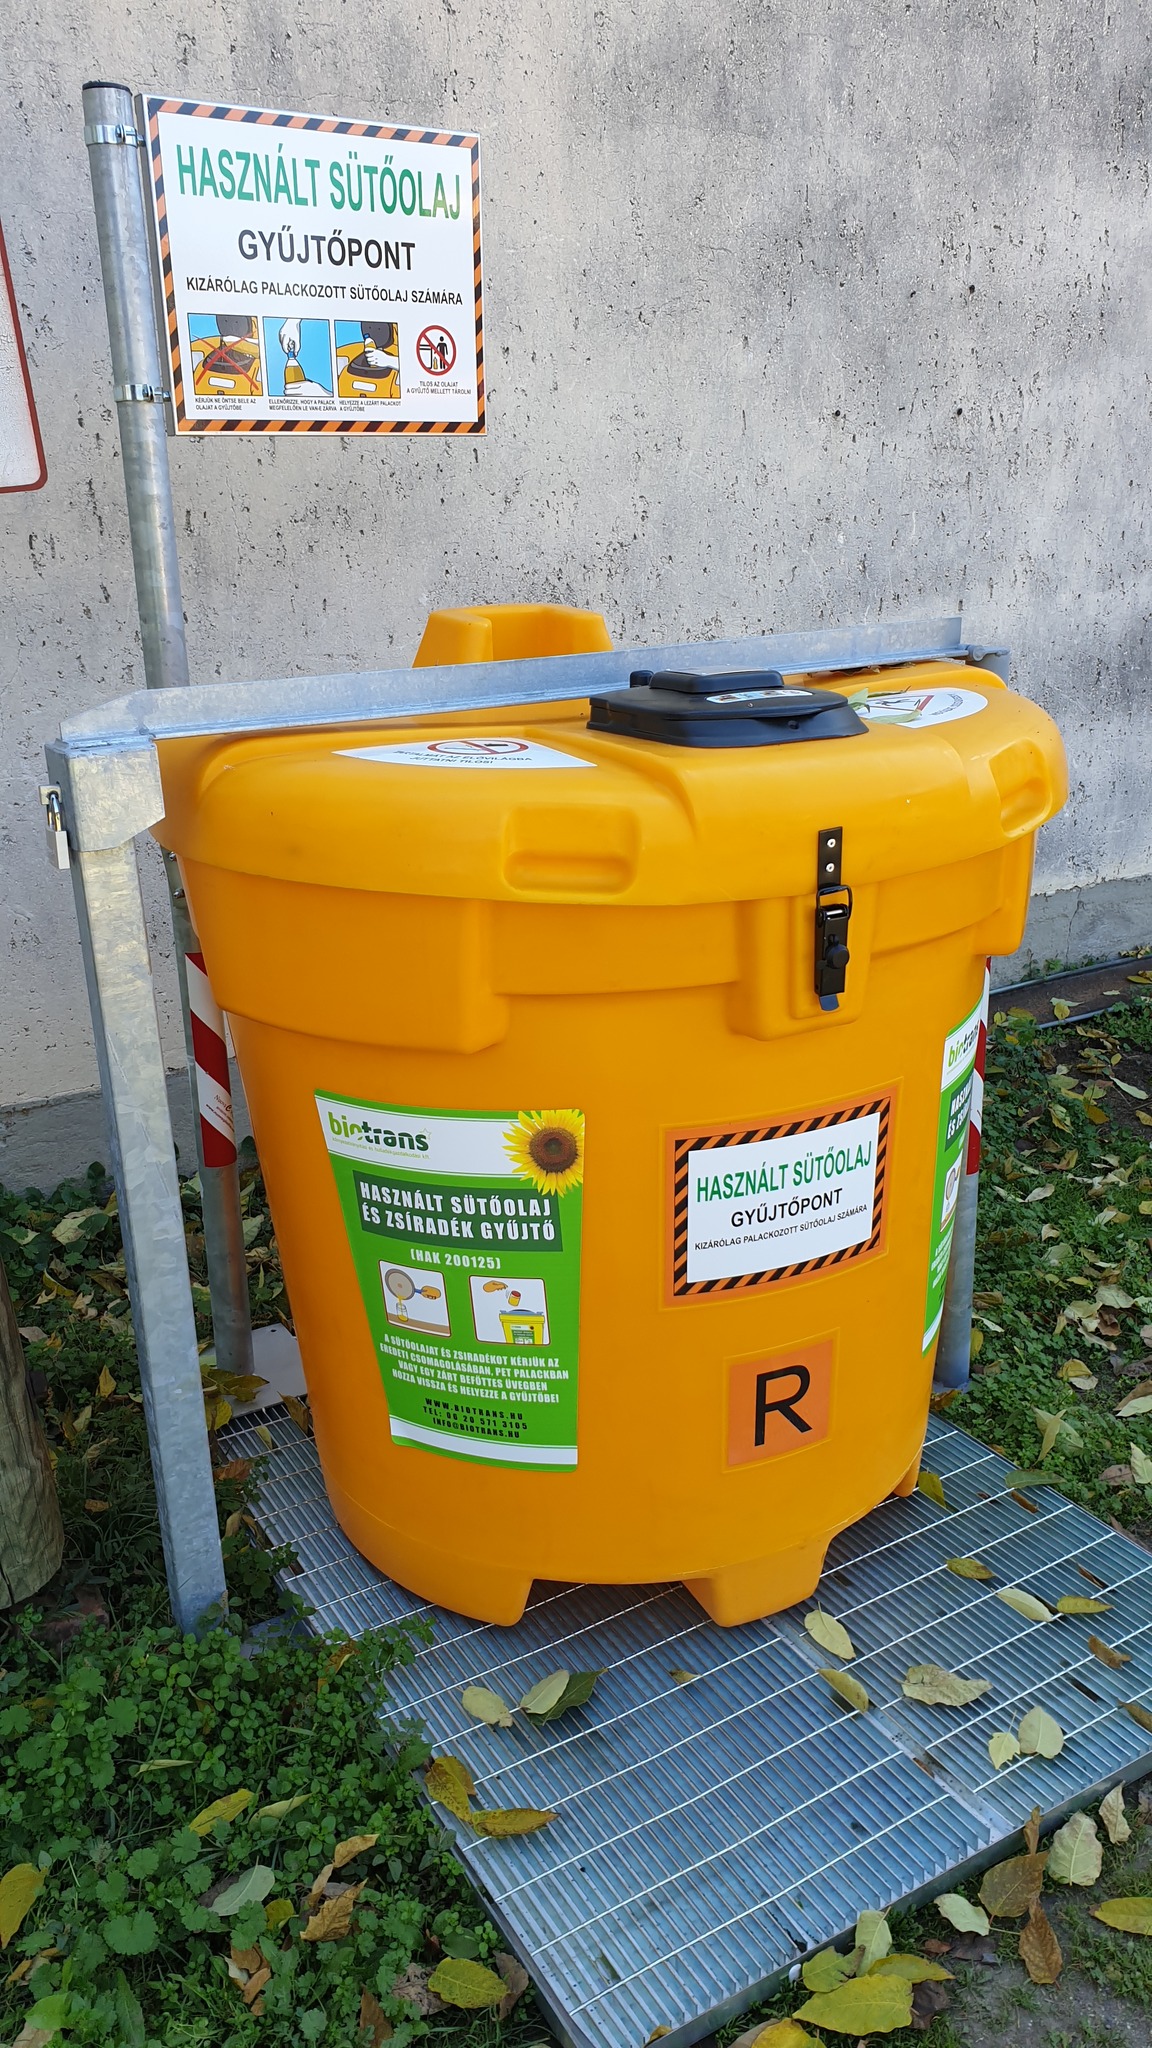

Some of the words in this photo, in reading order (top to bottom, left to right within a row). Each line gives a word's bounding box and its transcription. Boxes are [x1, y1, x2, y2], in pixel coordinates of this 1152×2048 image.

[176, 143, 320, 207] HASZNÁLT
[330, 151, 460, 220] SÜTŐOLAJ
[238, 225, 415, 270] GYŰJTŐPONT
[186, 275, 258, 294] KIZÁRÓLAG
[262, 282, 346, 299] PALACKOZOTT
[350, 284, 408, 302] SÜTŐOLAJ
[411, 288, 462, 305] SZÁMÁRA
[328, 1111, 429, 1151] biotrans
[697, 1162, 788, 1202] HASZNÁLT
[792, 1140, 872, 1186] SÜTŐOLAJ
[360, 1182, 443, 1212] HASZNÁLT
[450, 1194, 551, 1216] SÜTŐOLAJ
[732, 1188, 842, 1228] GYŰJTŐPONT
[362, 1202, 381, 1224] ÉS
[385, 1211, 474, 1238] ZSÍRADÉK
[480, 1220, 555, 1241] GYŰJTŐ
[695, 1236, 742, 1250] KIZÁRÓLAG
[744, 1226, 798, 1243] PALACKOZOTT
[837, 1204, 867, 1221] SZÁMÁRA
[411, 1248, 440, 1264] (HAK
[445, 1254, 501, 1270] 200125)
[380, 1343, 408, 1359] EREDETI
[495, 1367, 511, 1377] PET
[514, 1368, 569, 1379] PALACKBAN
[384, 1334, 390, 1343] A
[441, 1347, 451, 1358] ÉS
[510, 1355, 545, 1367] KÉRJÜK
[548, 1358, 559, 1368] AZ
[392, 1368, 416, 1384] HOZZA
[417, 1376, 446, 1391] VISSZA
[448, 1383, 458, 1394] ÉS
[460, 1386, 499, 1400] HELYEZZE
[501, 1391, 507, 1400] A
[398, 1360, 418, 1374] VAGY
[420, 1366, 435, 1377] EGY
[437, 1370, 457, 1382] ZÁRT
[505, 1379, 547, 1391] ÜVEGBEN
[423, 1406, 442, 1417] TEL:
[446, 1411, 458, 1420] 06
[463, 1415, 475, 1423] 20
[480, 1418, 497, 1427] 571
[502, 1420, 528, 1430] 3105
[425, 1398, 523, 1420] WWW.BIOTRANS.HU
[754, 1365, 812, 1446] R
[432, 1417, 520, 1438] INFO@BIOTRANS.HU
